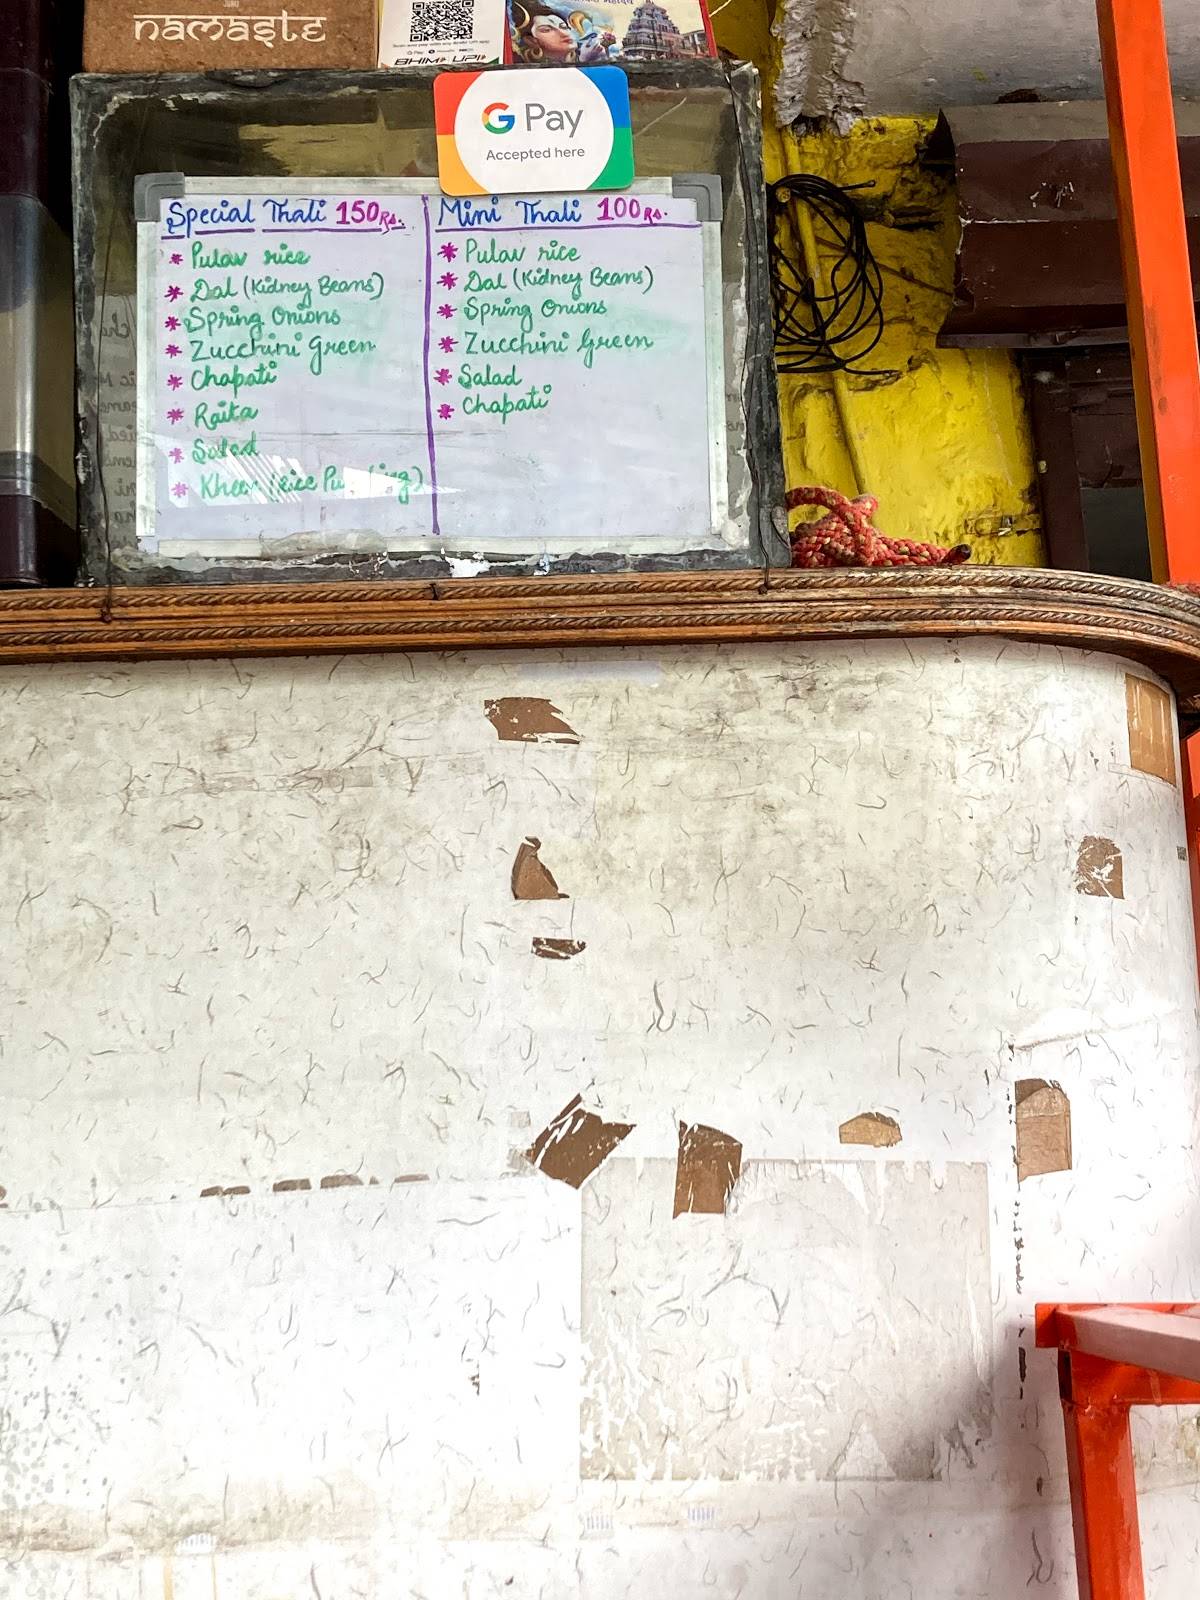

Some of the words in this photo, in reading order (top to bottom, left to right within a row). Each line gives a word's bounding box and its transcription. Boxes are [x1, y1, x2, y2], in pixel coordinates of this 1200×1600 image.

[525, 102, 584, 139] Pay
[486, 147, 551, 163] Accepted
[554, 146, 585, 159] here
[166, 201, 256, 234] Special
[263, 198, 328, 224] Thali
[437, 196, 503, 227] Mini
[515, 198, 582, 225] Thali
[537, 239, 582, 264] rice
[189, 275, 239, 301] Dal
[243, 274, 313, 310] (Kidney
[317, 271, 386, 301] Beans)
[463, 270, 508, 293] Dal
[512, 267, 583, 301] (Kidney
[589, 265, 655, 295] Beans)
[183, 305, 265, 342] Spring
[271, 306, 341, 326] Onions
[463, 296, 535, 334] Spring
[540, 298, 608, 318] Onions
[189, 332, 302, 364] Zucchini
[463, 331, 570, 355] Zucchini
[191, 360, 279, 399] Chapati
[457, 363, 523, 390] Salad
[462, 383, 553, 425] Chapati
